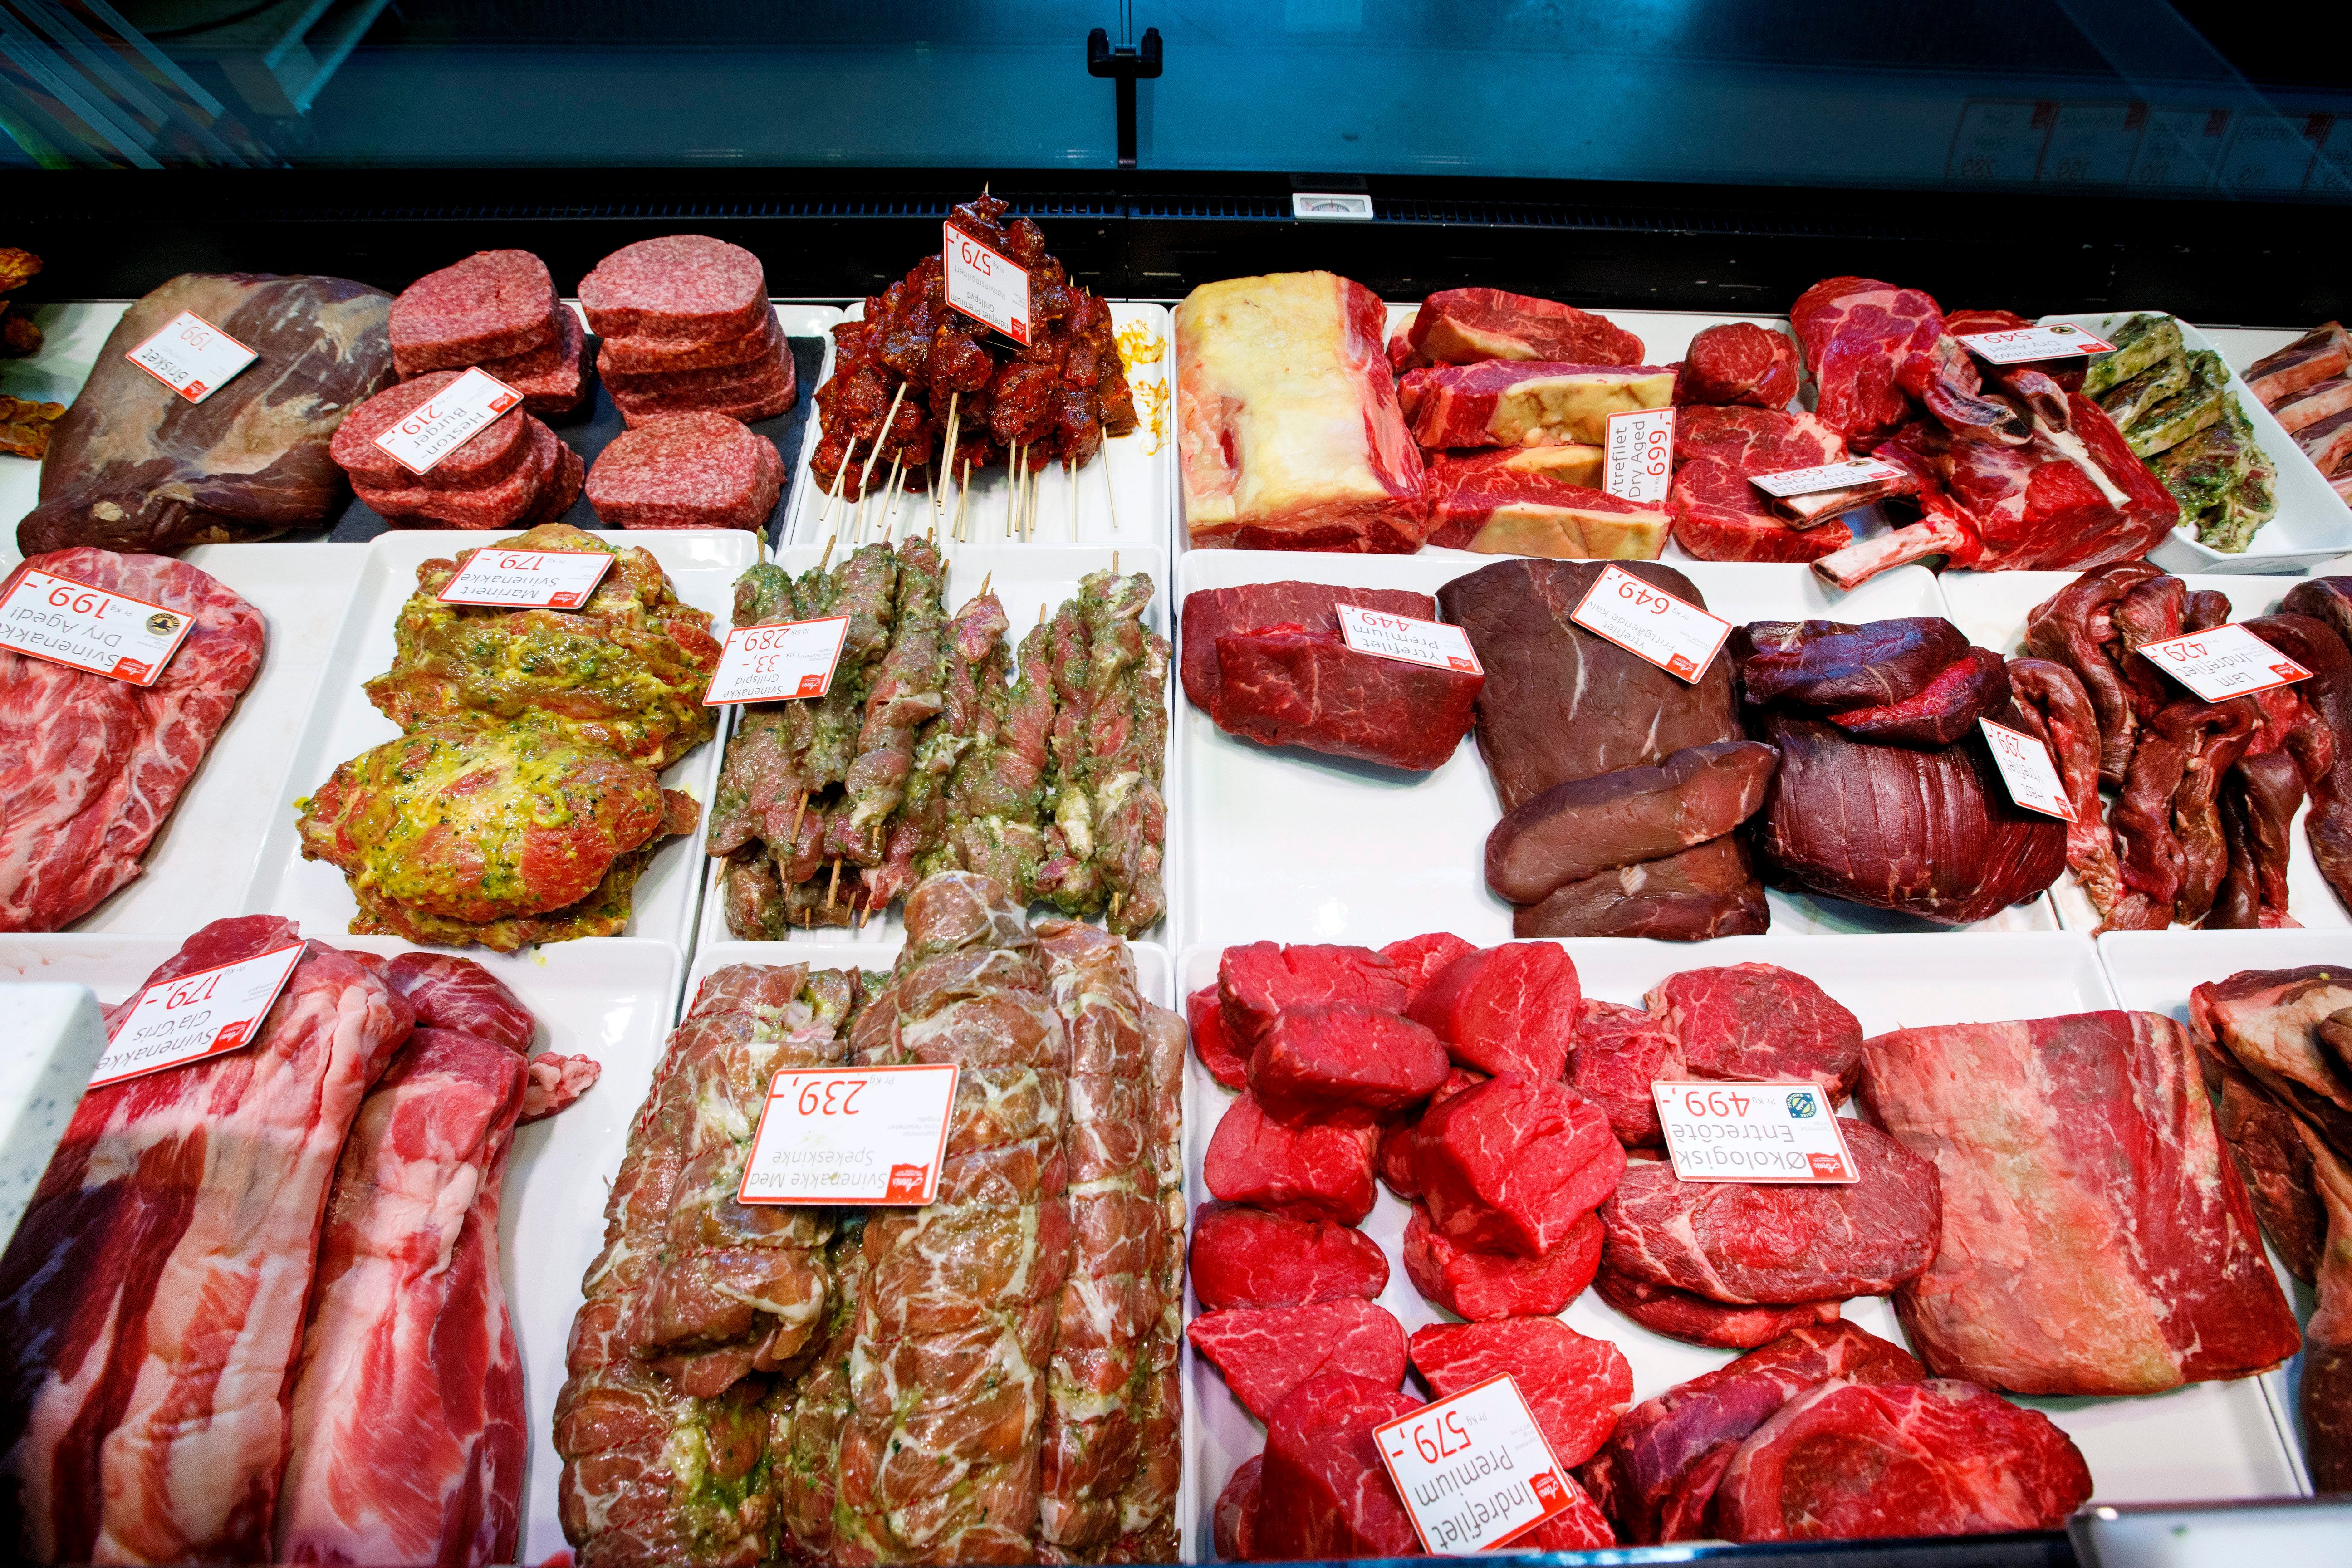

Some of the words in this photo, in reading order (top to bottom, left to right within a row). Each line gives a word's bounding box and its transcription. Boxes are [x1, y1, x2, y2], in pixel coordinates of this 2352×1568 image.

[947, 233, 991, 276] 579,-
[993, 261, 999, 270] Kg
[954, 265, 1005, 300] Rødvinsmarinert
[950, 293, 980, 315] Premium
[967, 291, 995, 311] Grillspyd
[982, 310, 1010, 332] Indrefilet
[175, 319, 215, 352] 199,-
[1966, 331, 2032, 343] 549,-
[1988, 343, 2027, 353] Aged
[1989, 346, 2078, 360] Tomahawk
[141, 348, 189, 384] Brisket
[436, 397, 445, 406] Kg
[386, 404, 443, 445] 219,-
[412, 407, 468, 449] Burger
[421, 412, 485, 459] Heston-
[1631, 421, 1646, 463] Aged
[1647, 413, 1671, 476] 699,-
[1612, 427, 1627, 496] Ytrefilet
[1628, 470, 1645, 498] Dry
[1756, 468, 1823, 481] 699,-
[1770, 475, 1817, 488] Aged
[1823, 470, 1854, 480] Dry
[479, 552, 544, 571] 179,-
[461, 573, 560, 587] Svinenakke
[23, 578, 111, 620] 199,-
[460, 586, 540, 599] Marinert
[1607, 573, 1670, 615] 649,-
[9, 605, 80, 633] Aged!
[109, 605, 121, 613] Kg
[1585, 601, 1609, 618] Kalv
[1671, 607, 1680, 617] Kg
[1681, 612, 1690, 621] Pr
[1343, 608, 1410, 632] 449,-
[82, 625, 122, 647] Dry
[728, 627, 790, 652] 289,-
[1352, 625, 1439, 649] Premium
[1602, 621, 1645, 649] Ytrefilet
[1611, 613, 1675, 652] Frittgående
[0, 622, 120, 667] Svinenakk
[1361, 638, 1440, 662] Ytrefilet
[2148, 641, 2208, 661] 429,-
[742, 654, 780, 673] 33,-
[1672, 659, 1693, 672] Annis
[2175, 652, 2253, 677] Indrefilet
[735, 673, 779, 686] Grillspid
[801, 682, 821, 690] Annis
[2215, 671, 2257, 688] Lam
[723, 685, 783, 698] Svinenakke
[1989, 725, 2026, 760] 299,-
[2003, 758, 2045, 785] Ytrefilet
[2020, 783, 2047, 804] Hest
[224, 966, 235, 976] Kg
[236, 964, 246, 973] Pr
[144, 973, 222, 1010] 179,-
[133, 1009, 212, 1044] Gla'Gris
[98, 1026, 218, 1073] Svinenakke
[869, 1075, 882, 1086] Kg
[883, 1076, 895, 1086] Pr
[769, 1076, 867, 1116] 239,-
[1661, 1088, 1750, 1117] 499,-
[1751, 1096, 1764, 1105] Kg
[1796, 1098, 1807, 1112] Debio
[1671, 1123, 1794, 1143] Entrecôtè
[772, 1147, 875, 1166] Spekeskinke
[1675, 1146, 1807, 1170] Økologisk
[1813, 1162, 1840, 1173] Annis
[749, 1172, 786, 1188] Med
[791, 1171, 887, 1190] Svinenakke
[892, 1177, 923, 1192] Annis
[1465, 1415, 1477, 1427] Kg
[1477, 1411, 1487, 1422] Pr
[1392, 1411, 1472, 1464] 579,-
[1509, 1425, 1524, 1436] Prime
[1522, 1423, 1532, 1432] NRF
[1522, 1429, 1536, 1439] Norge
[1413, 1445, 1514, 1508] Premium
[1538, 1482, 1559, 1500] Annis
[1431, 1480, 1533, 1550] Indrefilet
